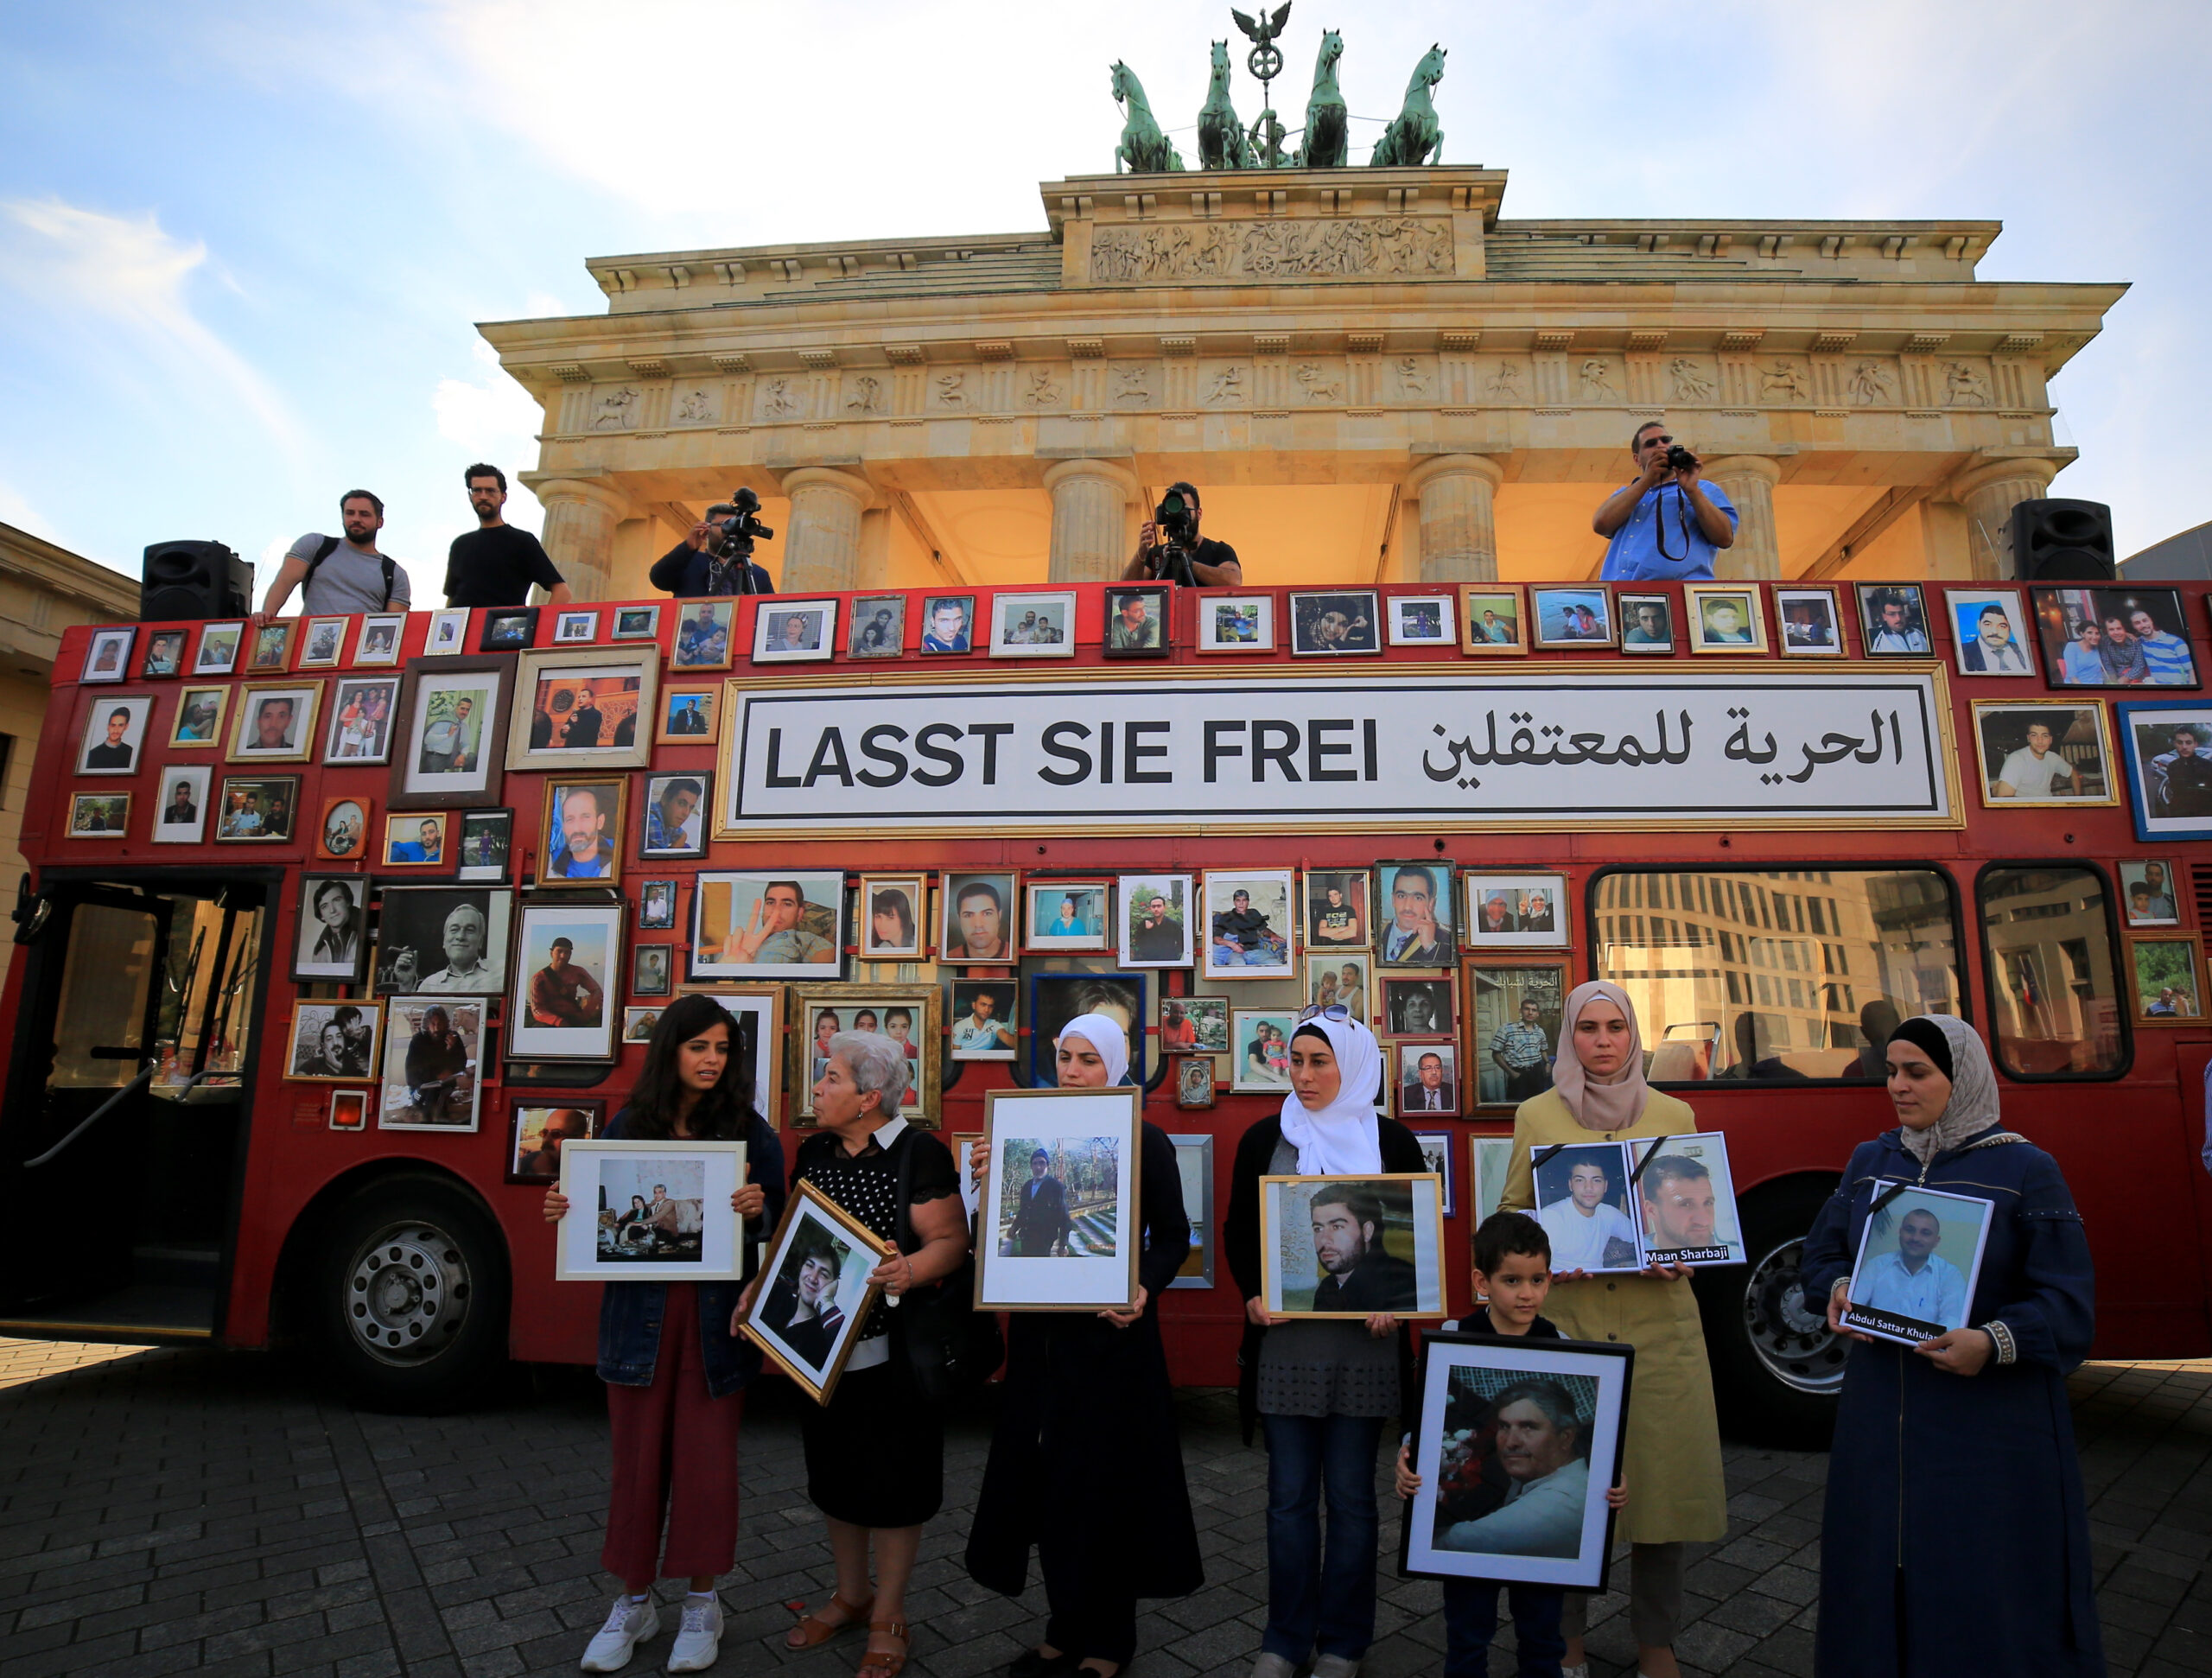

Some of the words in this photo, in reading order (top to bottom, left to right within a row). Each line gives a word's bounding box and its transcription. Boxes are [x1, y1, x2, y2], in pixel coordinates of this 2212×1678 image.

[766, 723, 1014, 789] LASST
[1037, 721, 1173, 786] SIE
[1204, 719, 1378, 783] FREI
[1421, 708, 1694, 790] للمعتقلين
[1724, 707, 1904, 786] الحرية
[1528, 976, 1558, 989] الحرية
[1645, 1251, 1678, 1262] Maan
[1680, 1247, 1728, 1261] Sharbaji
[1848, 1313, 1876, 1326] Abdul
[1876, 1319, 1905, 1333] Sattar
